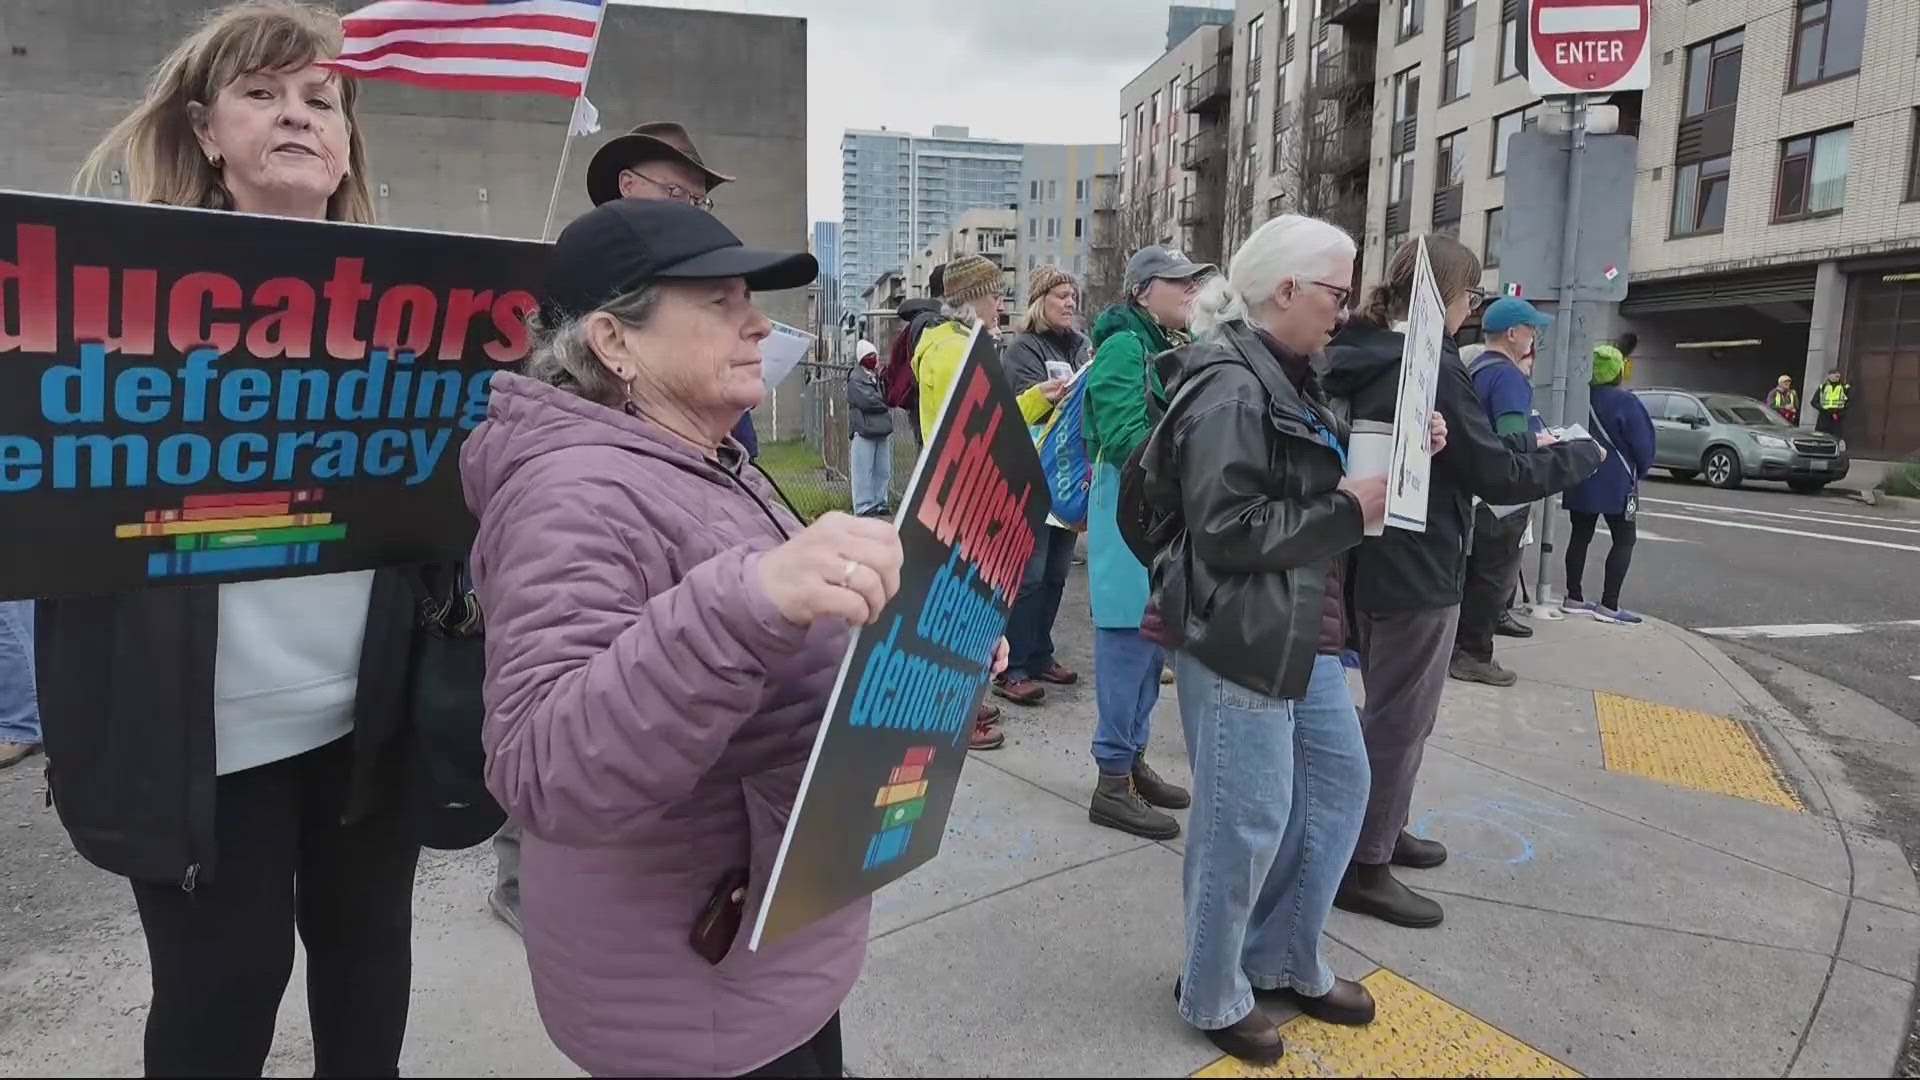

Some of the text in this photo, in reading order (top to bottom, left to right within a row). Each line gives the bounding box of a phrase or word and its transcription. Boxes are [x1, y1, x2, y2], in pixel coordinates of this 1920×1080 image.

[1555, 41, 1624, 64] ENTER
[917, 363, 1035, 608] Educators
[849, 615, 979, 747] democracy
[917, 543, 1006, 684] defending
